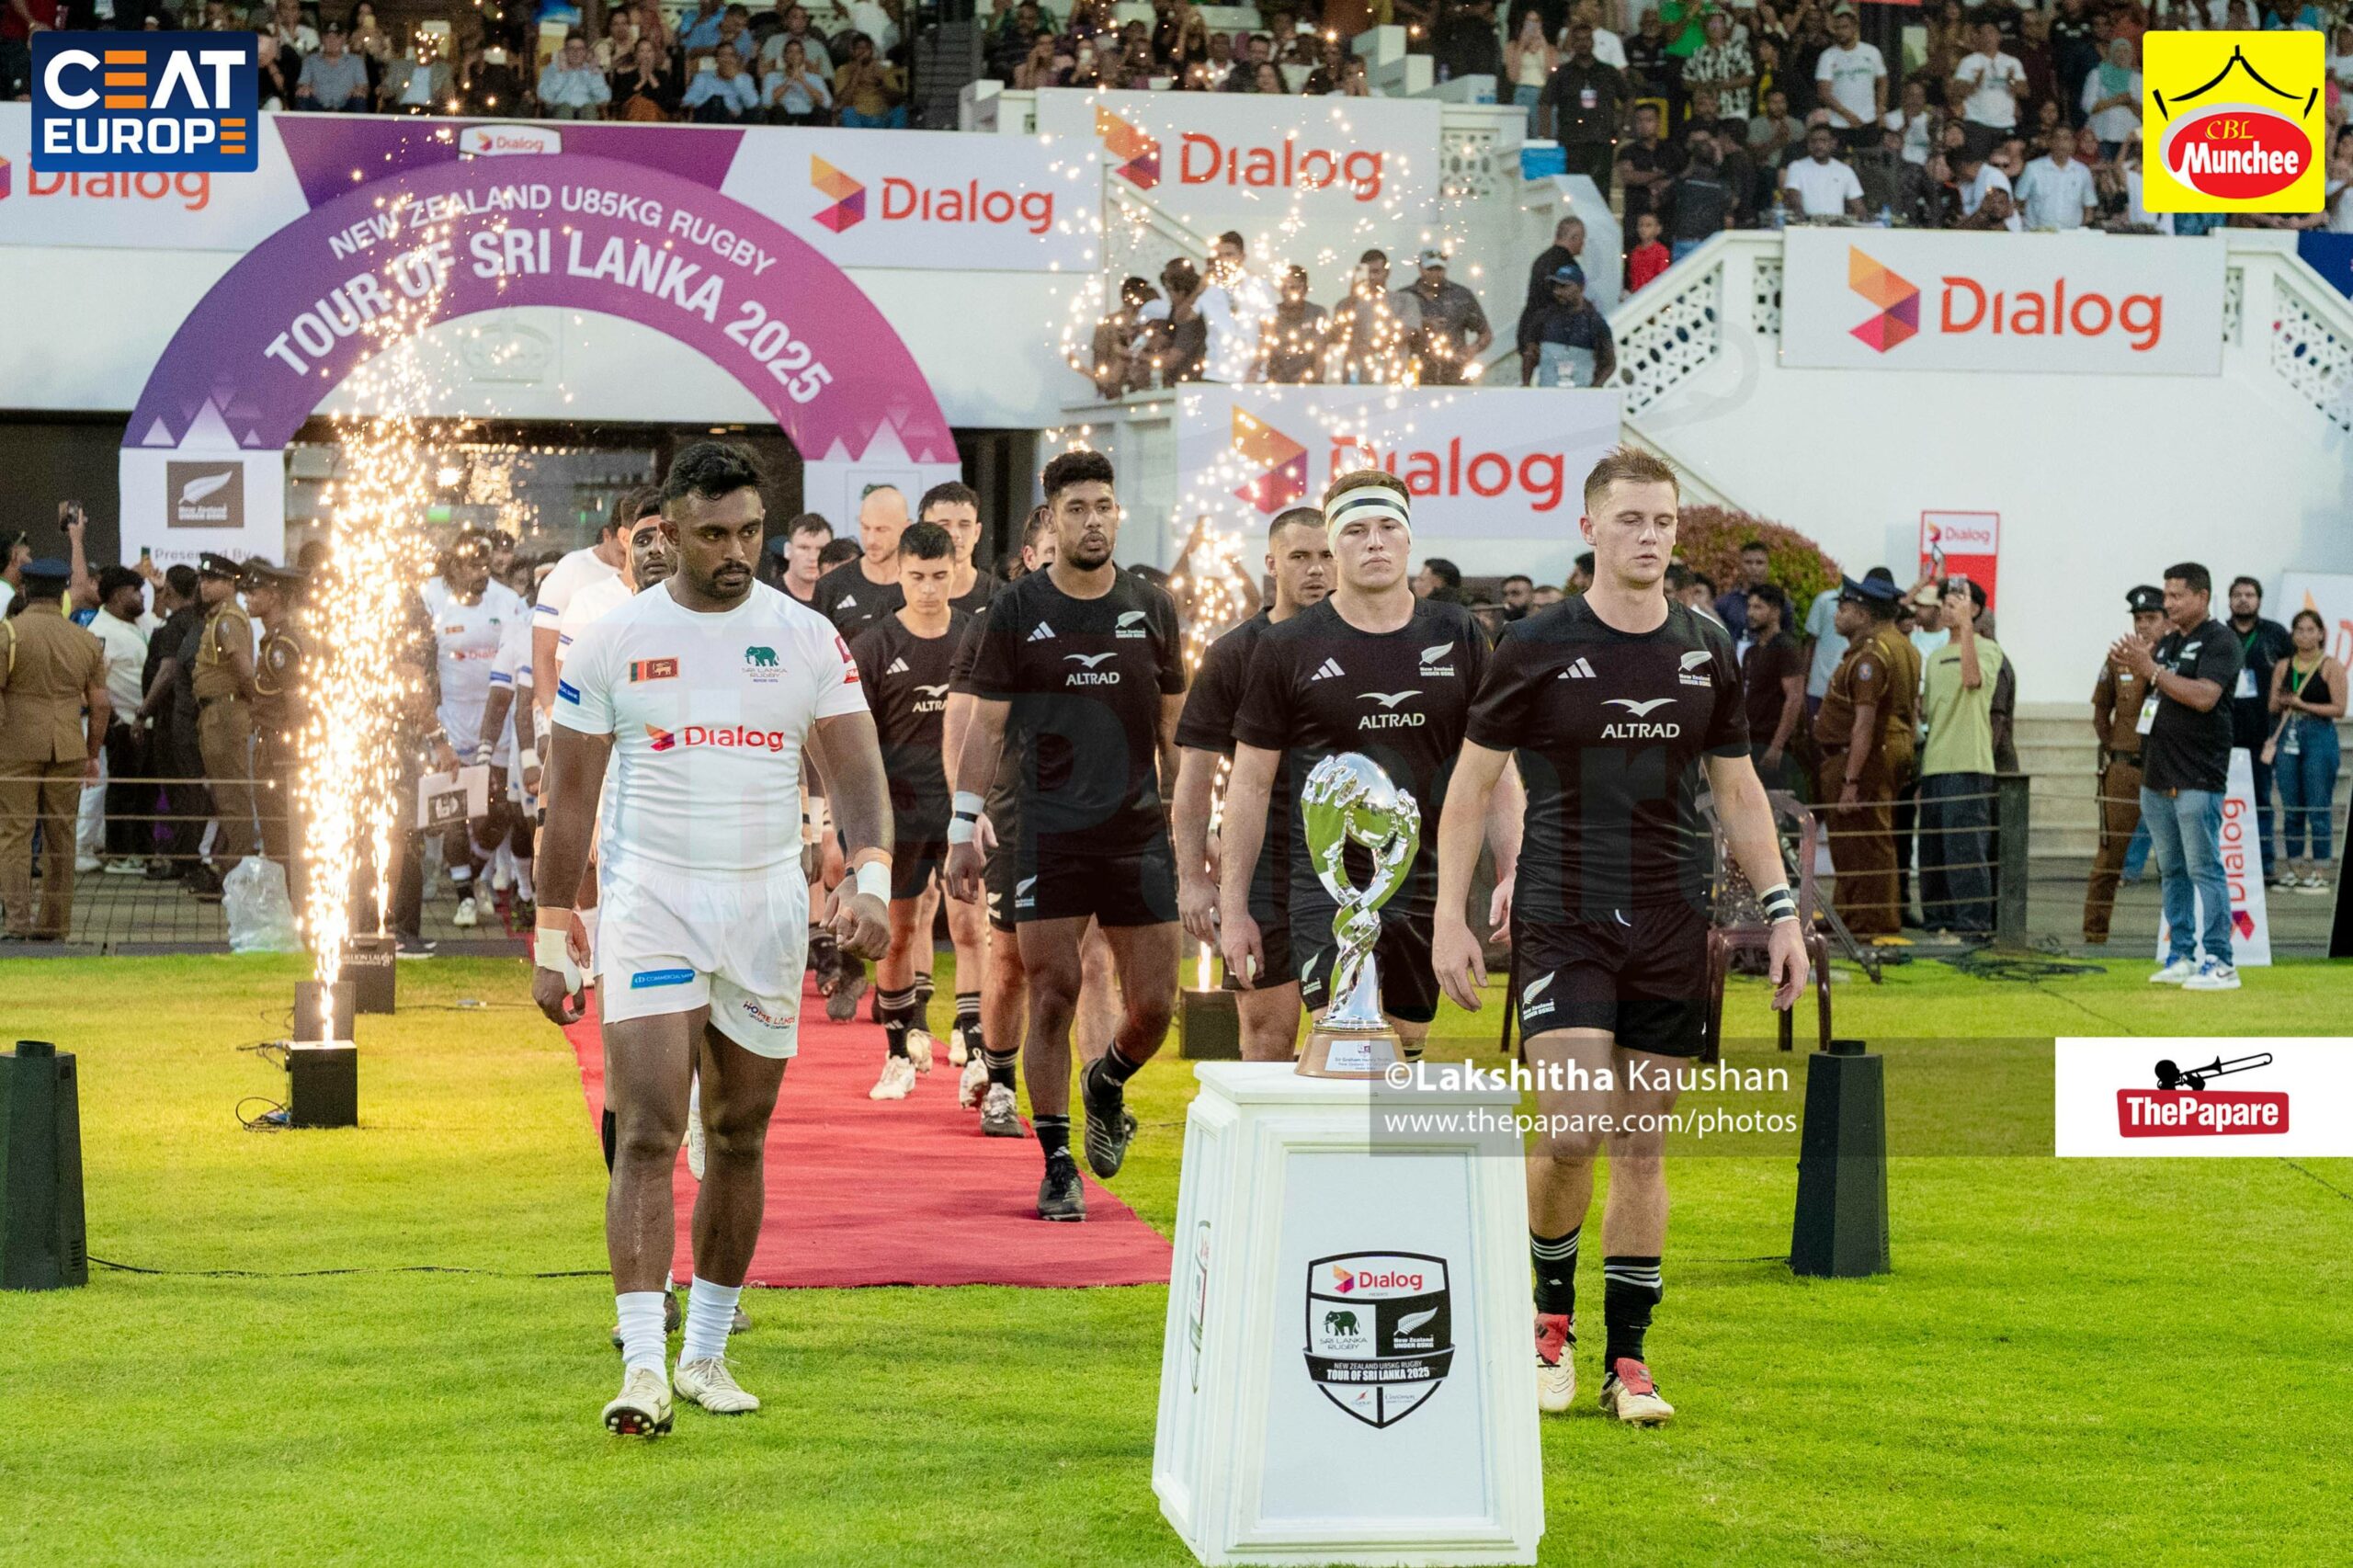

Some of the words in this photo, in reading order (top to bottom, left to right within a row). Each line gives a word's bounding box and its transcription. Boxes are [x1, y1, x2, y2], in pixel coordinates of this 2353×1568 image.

[1178, 132, 1383, 202] Dialog
[881, 176, 1055, 233] Dialog
[329, 212, 399, 260] NEW
[409, 184, 551, 229] ZEALAND
[561, 186, 662, 226] U85KG
[667, 208, 778, 277] RUGBY
[263, 274, 392, 377] TOUR
[396, 243, 457, 299] OF
[471, 228, 550, 279] SRI
[566, 230, 725, 324] LANKA
[722, 300, 833, 404] 2025
[1940, 276, 2163, 352] Dialog
[1065, 672, 1120, 686] ALTRAD
[912, 699, 949, 713] ALTRA
[1358, 713, 1426, 730] ALTRAD
[1600, 723, 1680, 739] ALTRAD
[684, 725, 784, 753] Dialog
[1359, 1271, 1423, 1290] Dialog
[1326, 1369, 1349, 1381] TOUR
[1350, 1369, 1361, 1381] OF
[1362, 1369, 1378, 1381] SRI
[1379, 1369, 1406, 1381] LANKA
[1407, 1367, 1430, 1378] 2025
